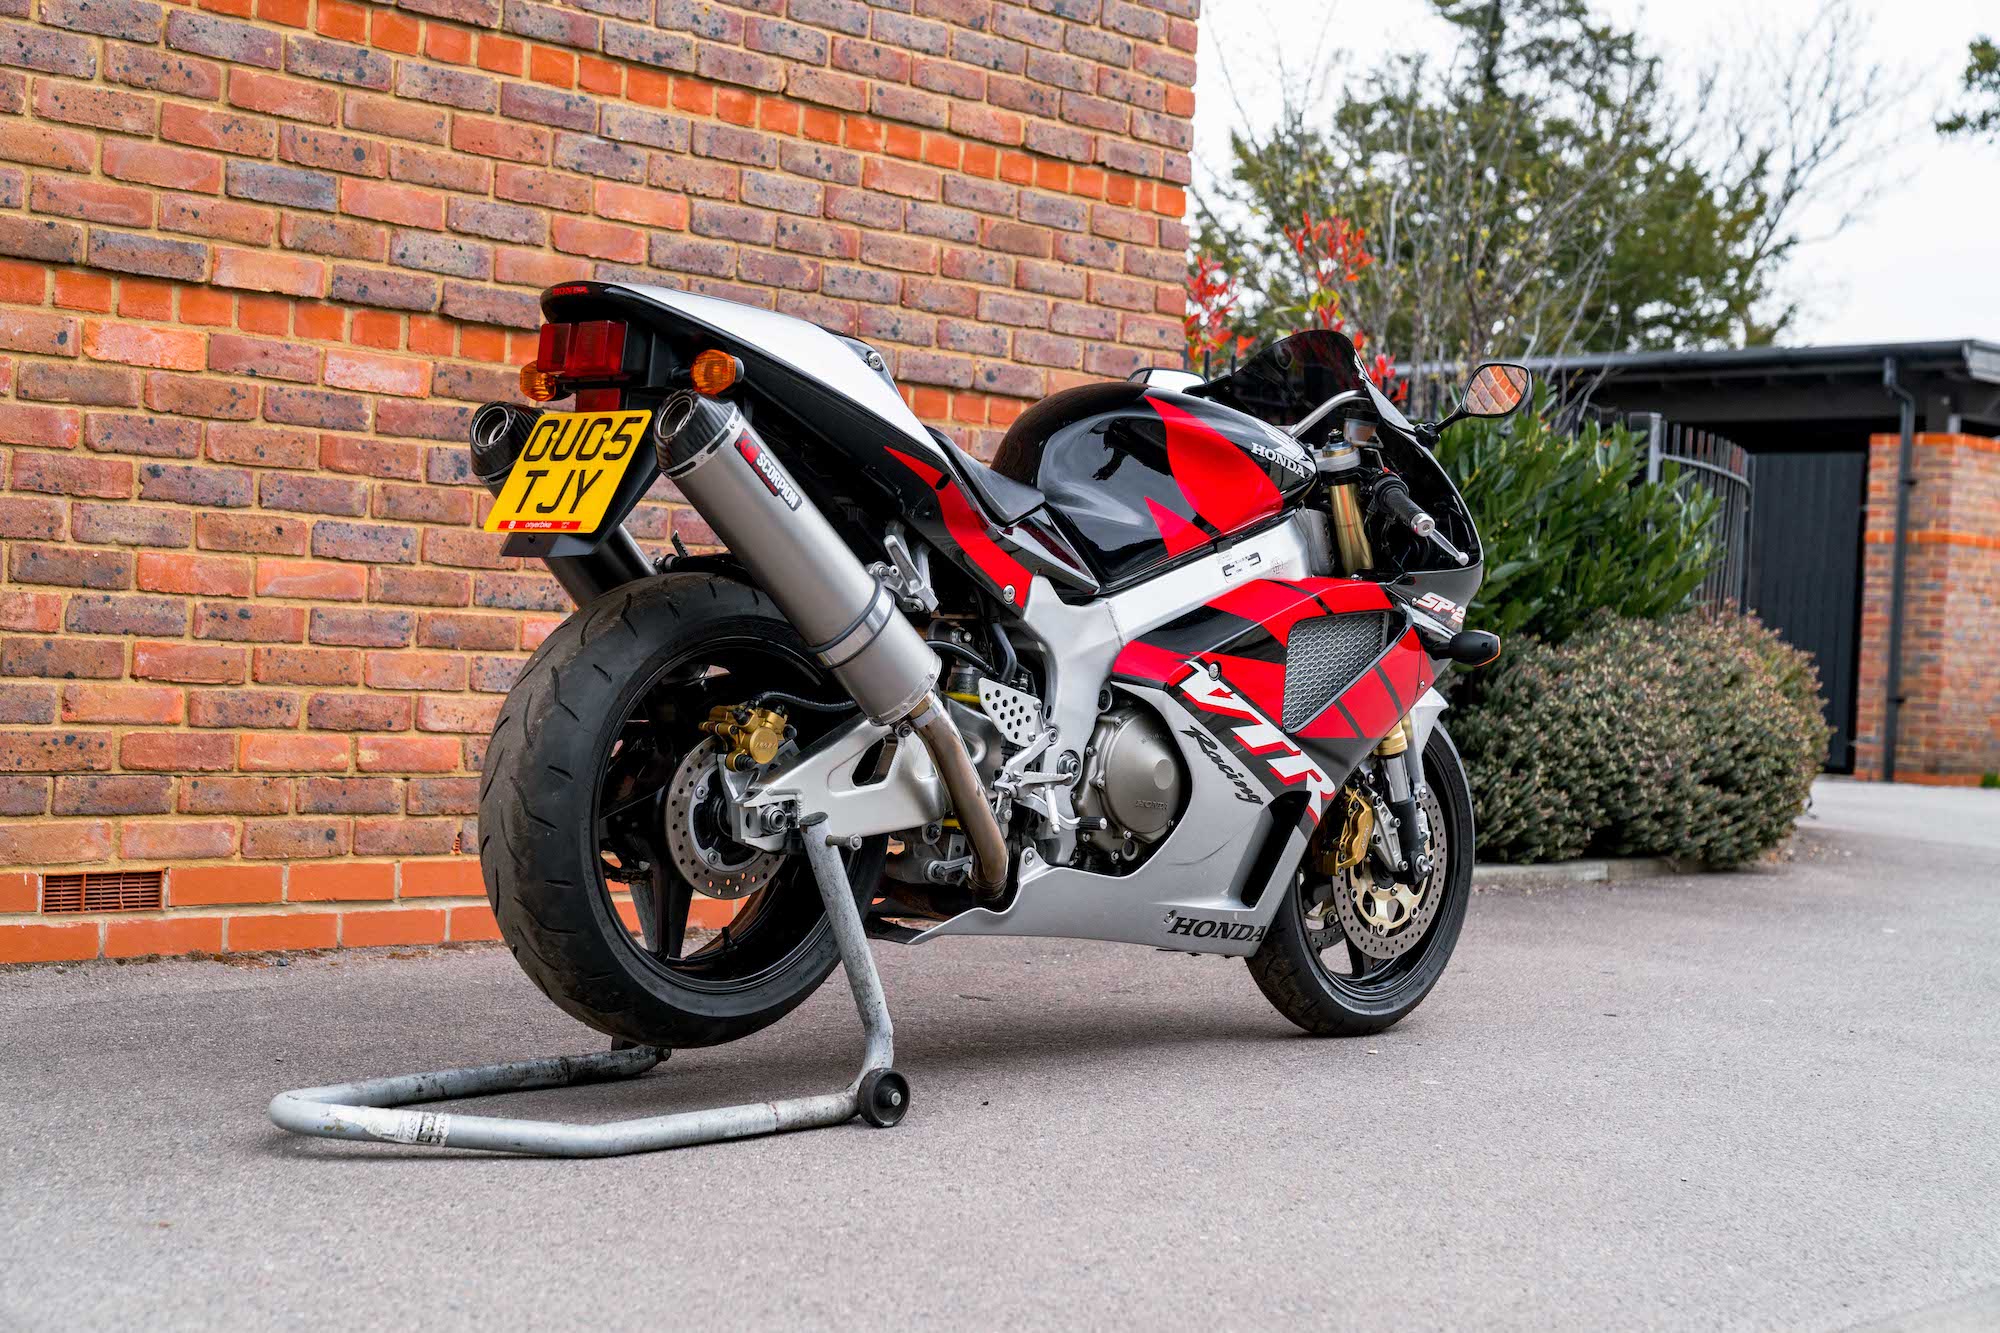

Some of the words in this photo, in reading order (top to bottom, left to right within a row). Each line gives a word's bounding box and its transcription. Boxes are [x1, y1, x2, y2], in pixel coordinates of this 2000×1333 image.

[756, 452, 799, 508] SCORPION
[1251, 441, 1305, 479] HONDA
[515, 469, 604, 514] TJY
[1178, 725, 1264, 806] Racing
[1179, 661, 1336, 820] VTR
[1167, 916, 1267, 942] HONDA
